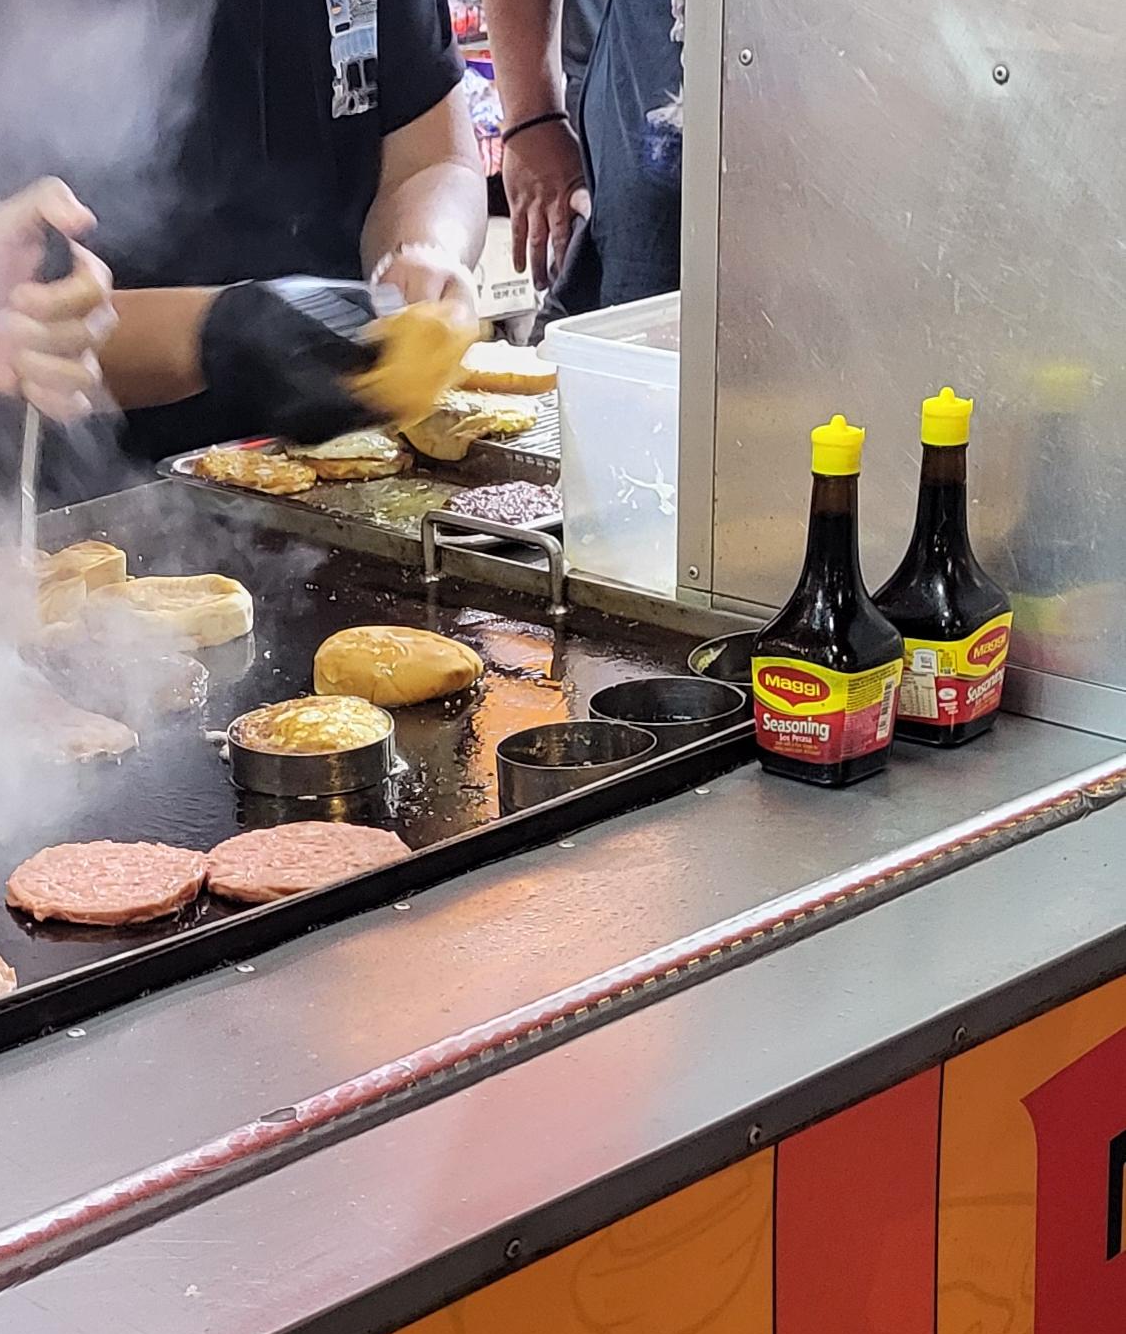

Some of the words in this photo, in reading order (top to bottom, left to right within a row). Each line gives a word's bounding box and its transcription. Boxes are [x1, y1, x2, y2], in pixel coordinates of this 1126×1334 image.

[973, 630, 1008, 660] Maggi
[764, 673, 822, 697] Maggi
[762, 713, 831, 742] Seasoning
